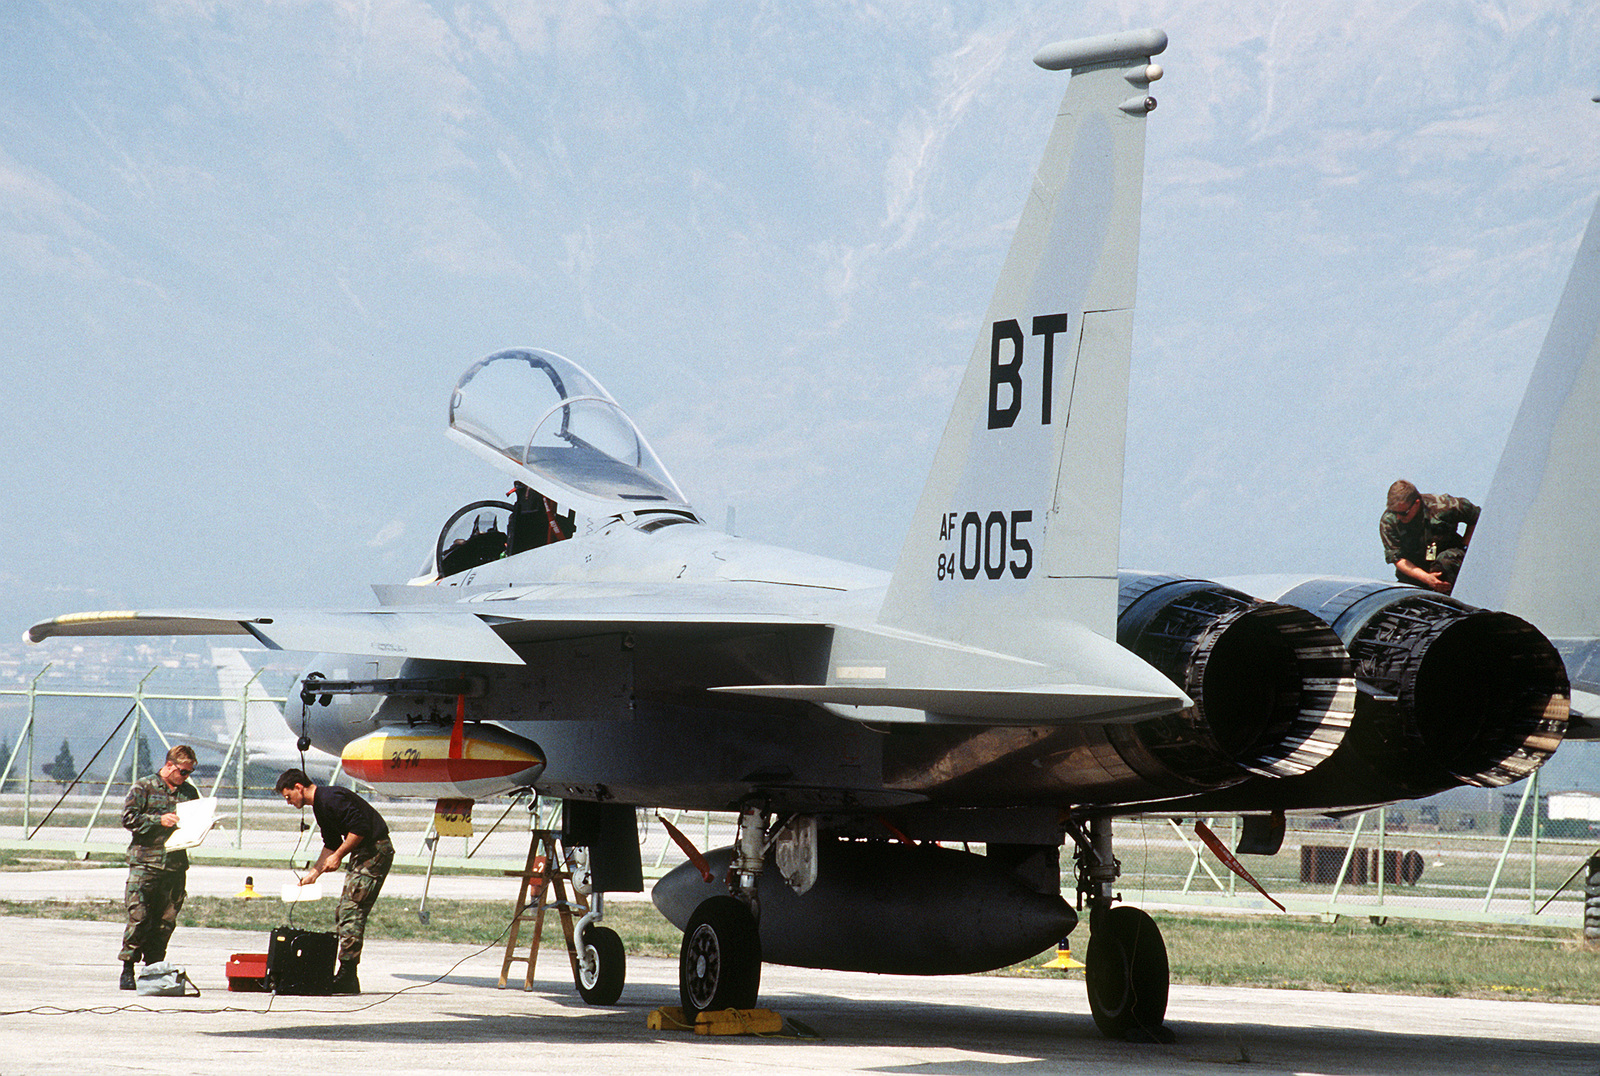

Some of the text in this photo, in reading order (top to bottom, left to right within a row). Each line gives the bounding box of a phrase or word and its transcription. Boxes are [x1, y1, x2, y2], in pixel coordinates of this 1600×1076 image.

[987, 313, 1068, 430] BT
[939, 512, 958, 541] AF
[959, 510, 1033, 580] 005
[937, 553, 955, 581] 84
